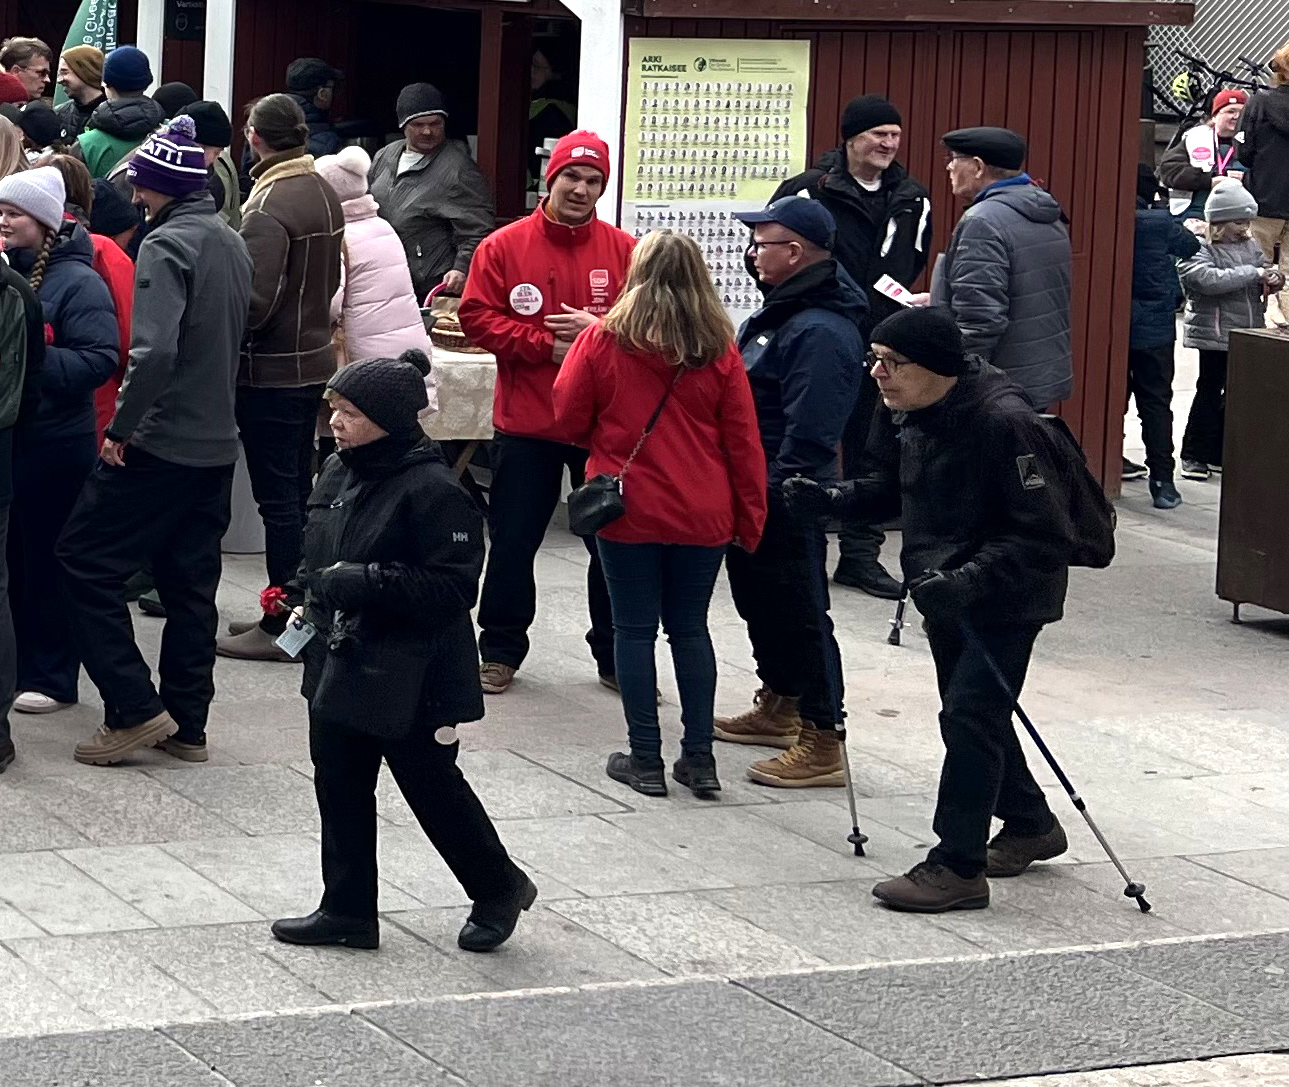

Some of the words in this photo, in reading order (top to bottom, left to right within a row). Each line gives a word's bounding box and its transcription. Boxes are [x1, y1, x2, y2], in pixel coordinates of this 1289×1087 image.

[641, 55, 662, 63] ARKI
[641, 64, 687, 73] RATKAISEE
[140, 137, 183, 165] ATTI
